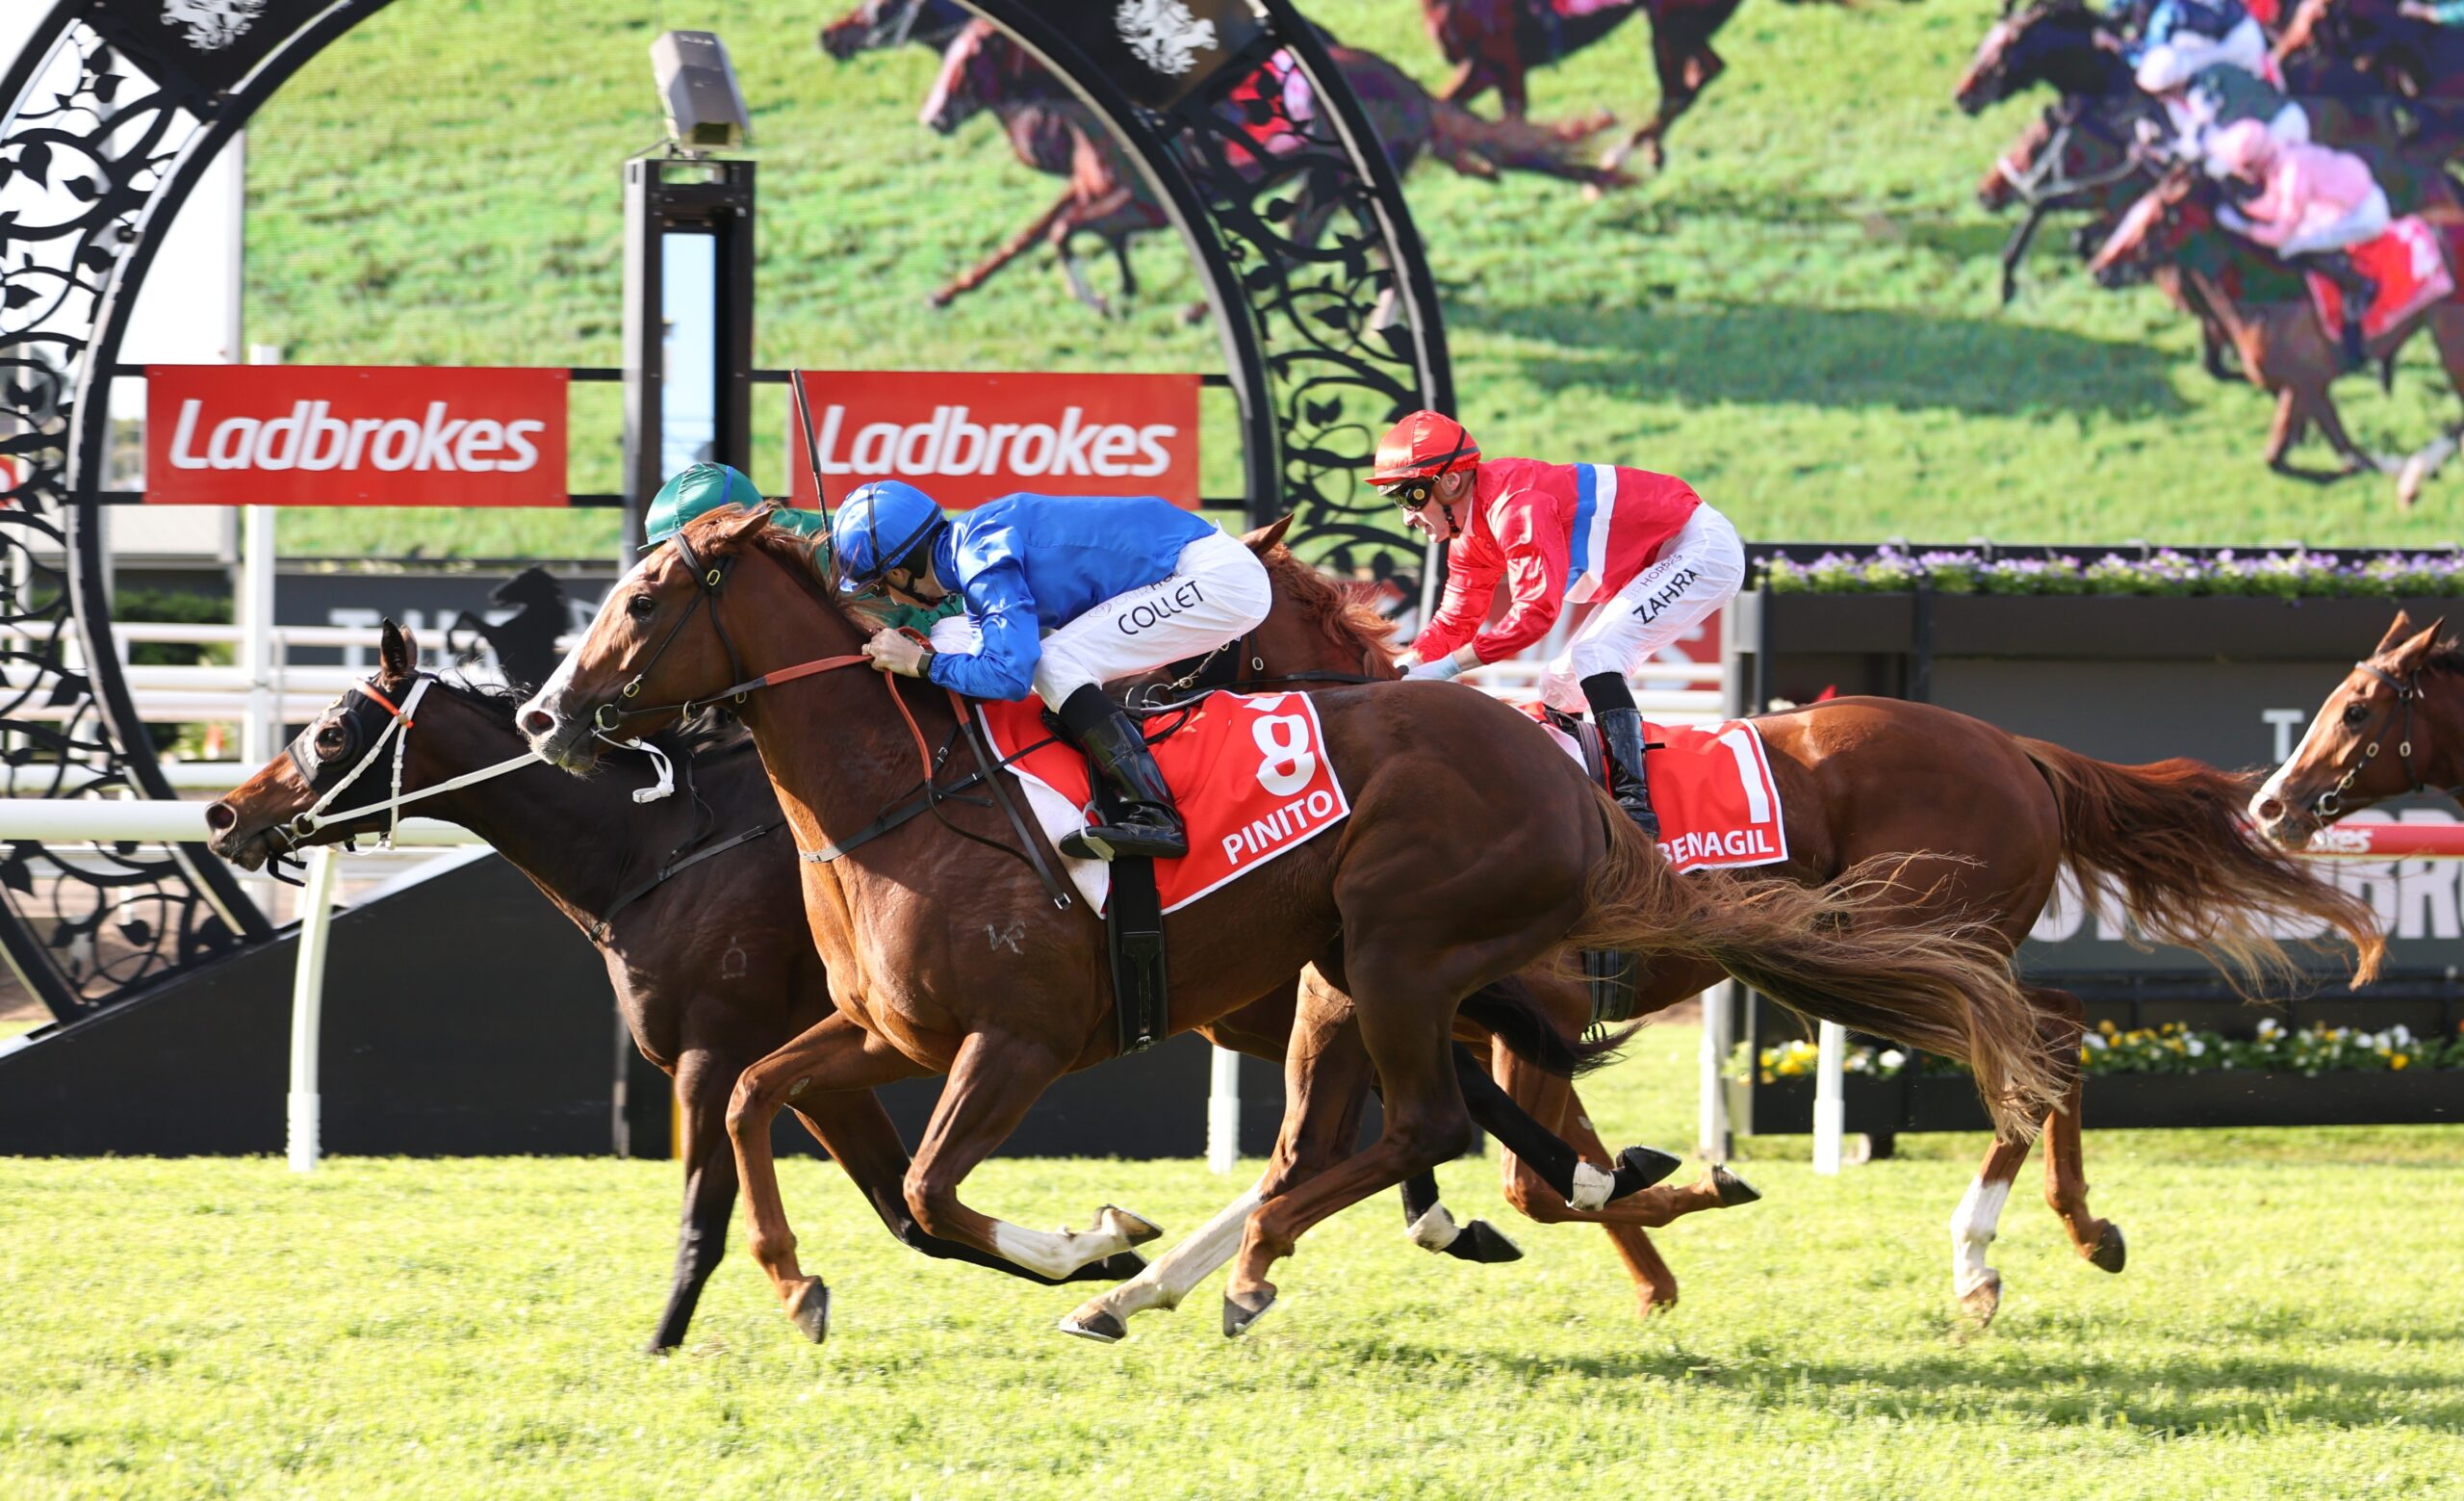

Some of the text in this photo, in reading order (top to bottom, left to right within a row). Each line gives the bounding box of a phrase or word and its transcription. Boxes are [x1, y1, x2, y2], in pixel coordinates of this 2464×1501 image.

[169, 399, 545, 472] Ladbrokes
[819, 404, 1177, 477] Ladbrokes
[1117, 580, 1204, 635] COLLET
[1631, 568, 1700, 625] ZAHRA
[1251, 713, 1317, 797] 8
[1717, 728, 1771, 824] 1
[1221, 789, 1334, 866] PINITO
